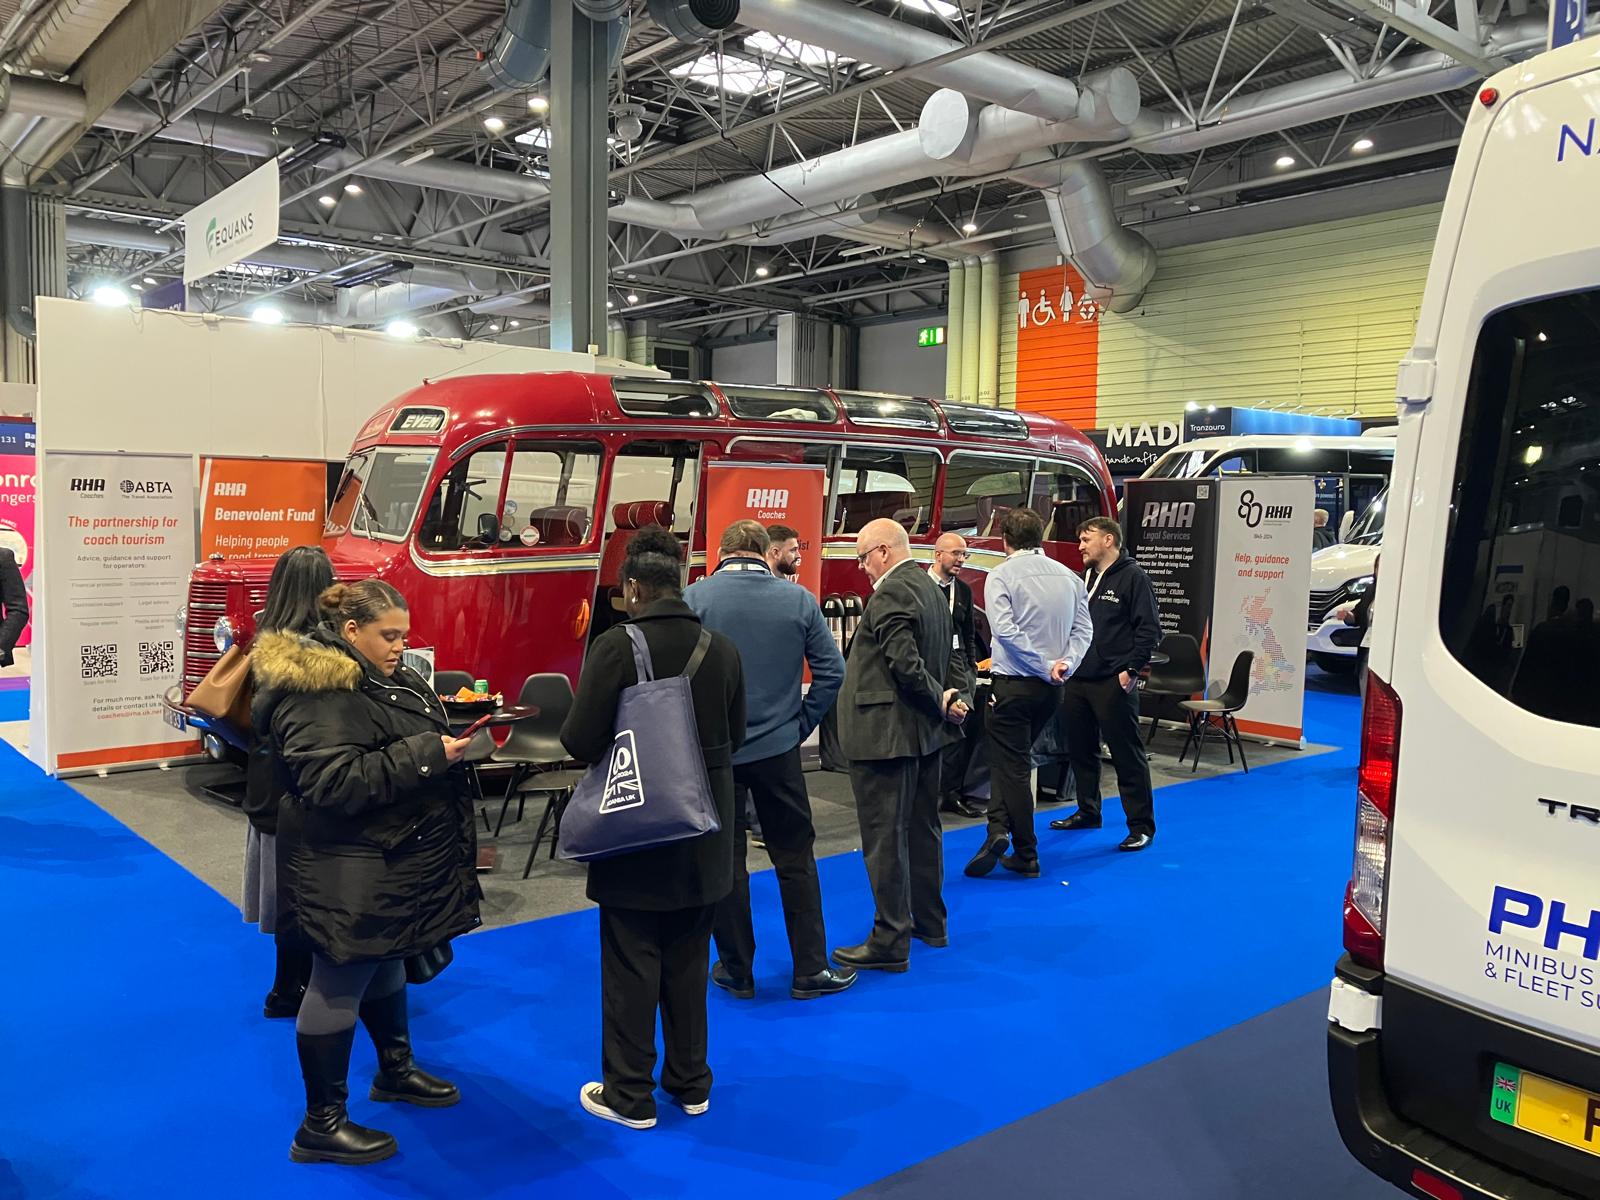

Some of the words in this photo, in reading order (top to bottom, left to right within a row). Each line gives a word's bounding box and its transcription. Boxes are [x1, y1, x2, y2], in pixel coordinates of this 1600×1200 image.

[1557, 118, 1600, 162] N
[215, 212, 254, 246] EQUANS
[1106, 421, 1185, 448] MAD
[1190, 424, 1226, 432] Tranzaura
[70, 478, 105, 491] RHA
[135, 481, 173, 493] ABTA
[213, 482, 247, 496] RHA
[746, 488, 789, 508] RHA
[215, 507, 284, 521] Benevolent
[286, 508, 316, 522] Fund
[757, 510, 786, 519] Coaches
[1141, 502, 1196, 528] RHA
[1265, 505, 1293, 519] RHA
[68, 516, 90, 527] The
[92, 516, 159, 530] partnership
[162, 516, 179, 527] for
[83, 534, 118, 545] coach
[122, 534, 165, 545] tourism
[215, 534, 253, 549] Helping
[255, 535, 289, 548] people
[1143, 531, 1161, 541] Legal
[1162, 531, 1191, 540] Services
[1254, 553, 1290, 565] guidance
[1237, 568, 1253, 577] and
[1254, 569, 1284, 580] support
[1488, 885, 1600, 961] PH
[1486, 940, 1594, 985] MINIBUS
[1485, 962, 1497, 979] &
[1505, 968, 1575, 1001] FLEET
[1495, 1098, 1512, 1113] UK
